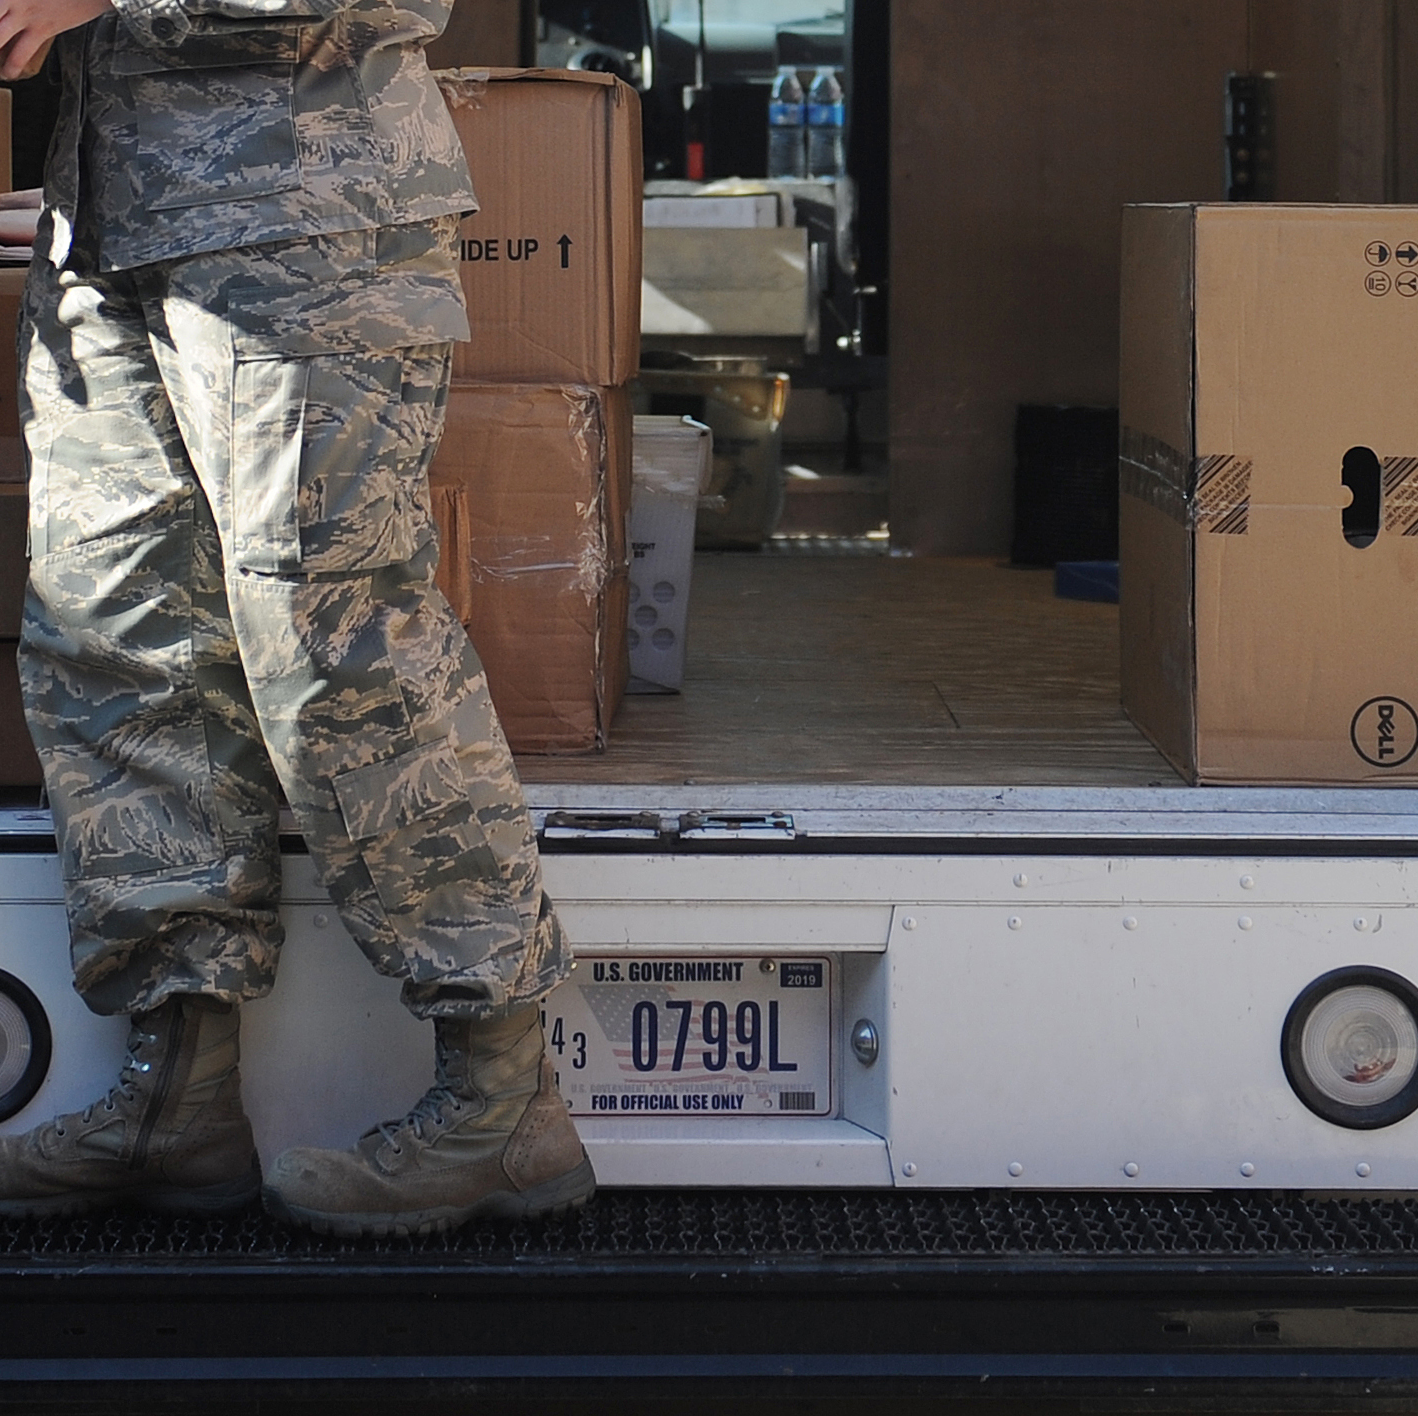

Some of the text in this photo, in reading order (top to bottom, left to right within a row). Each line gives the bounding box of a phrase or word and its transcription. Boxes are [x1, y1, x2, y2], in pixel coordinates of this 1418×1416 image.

[461, 239, 538, 261] IDE UP
[593, 962, 744, 982] U.S. GOVERNMENT
[787, 974, 816, 986] 2019
[632, 1000, 798, 1072] 0799L
[592, 1095, 744, 1110] FOR OFFICIAL USE ONLY
